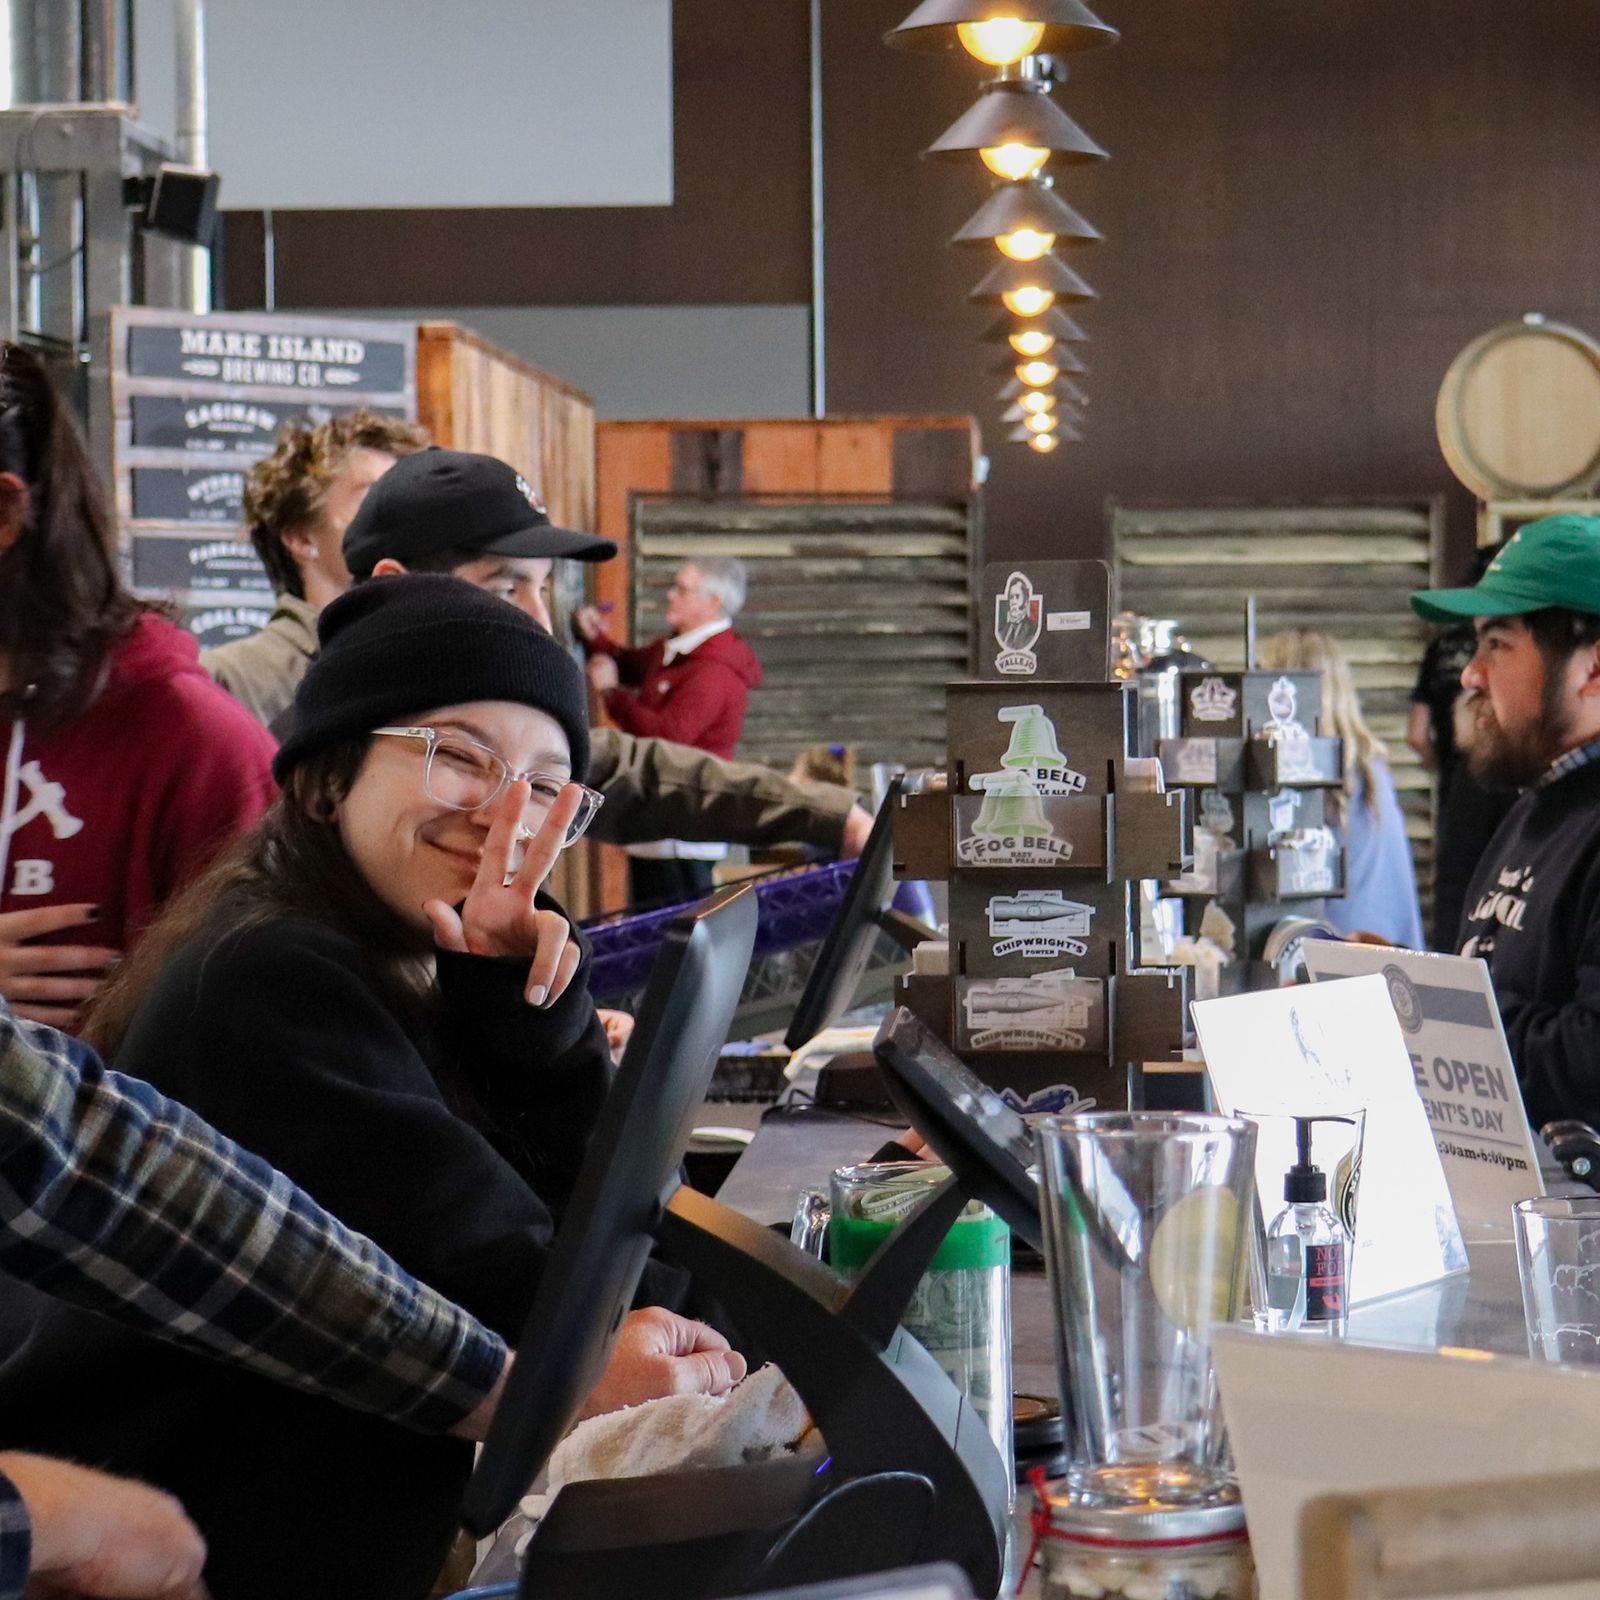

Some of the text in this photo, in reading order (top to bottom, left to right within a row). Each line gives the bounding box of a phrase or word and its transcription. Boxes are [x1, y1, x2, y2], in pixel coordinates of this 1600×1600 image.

[181, 329, 365, 365] MARE ISLAND
[222, 358, 295, 386] BREWING
[999, 657, 1035, 670] VALLEJO
[1037, 768, 1083, 789] BELL
[974, 836, 1016, 858] FOG
[1023, 836, 1070, 858] BELL
[994, 938, 1084, 955] SHIPWRIGHT'S
[973, 1028, 1065, 1046] SHIPWRIGHT'S
[1432, 1056, 1509, 1102] OPEN
[1470, 1106, 1504, 1134] DAY
